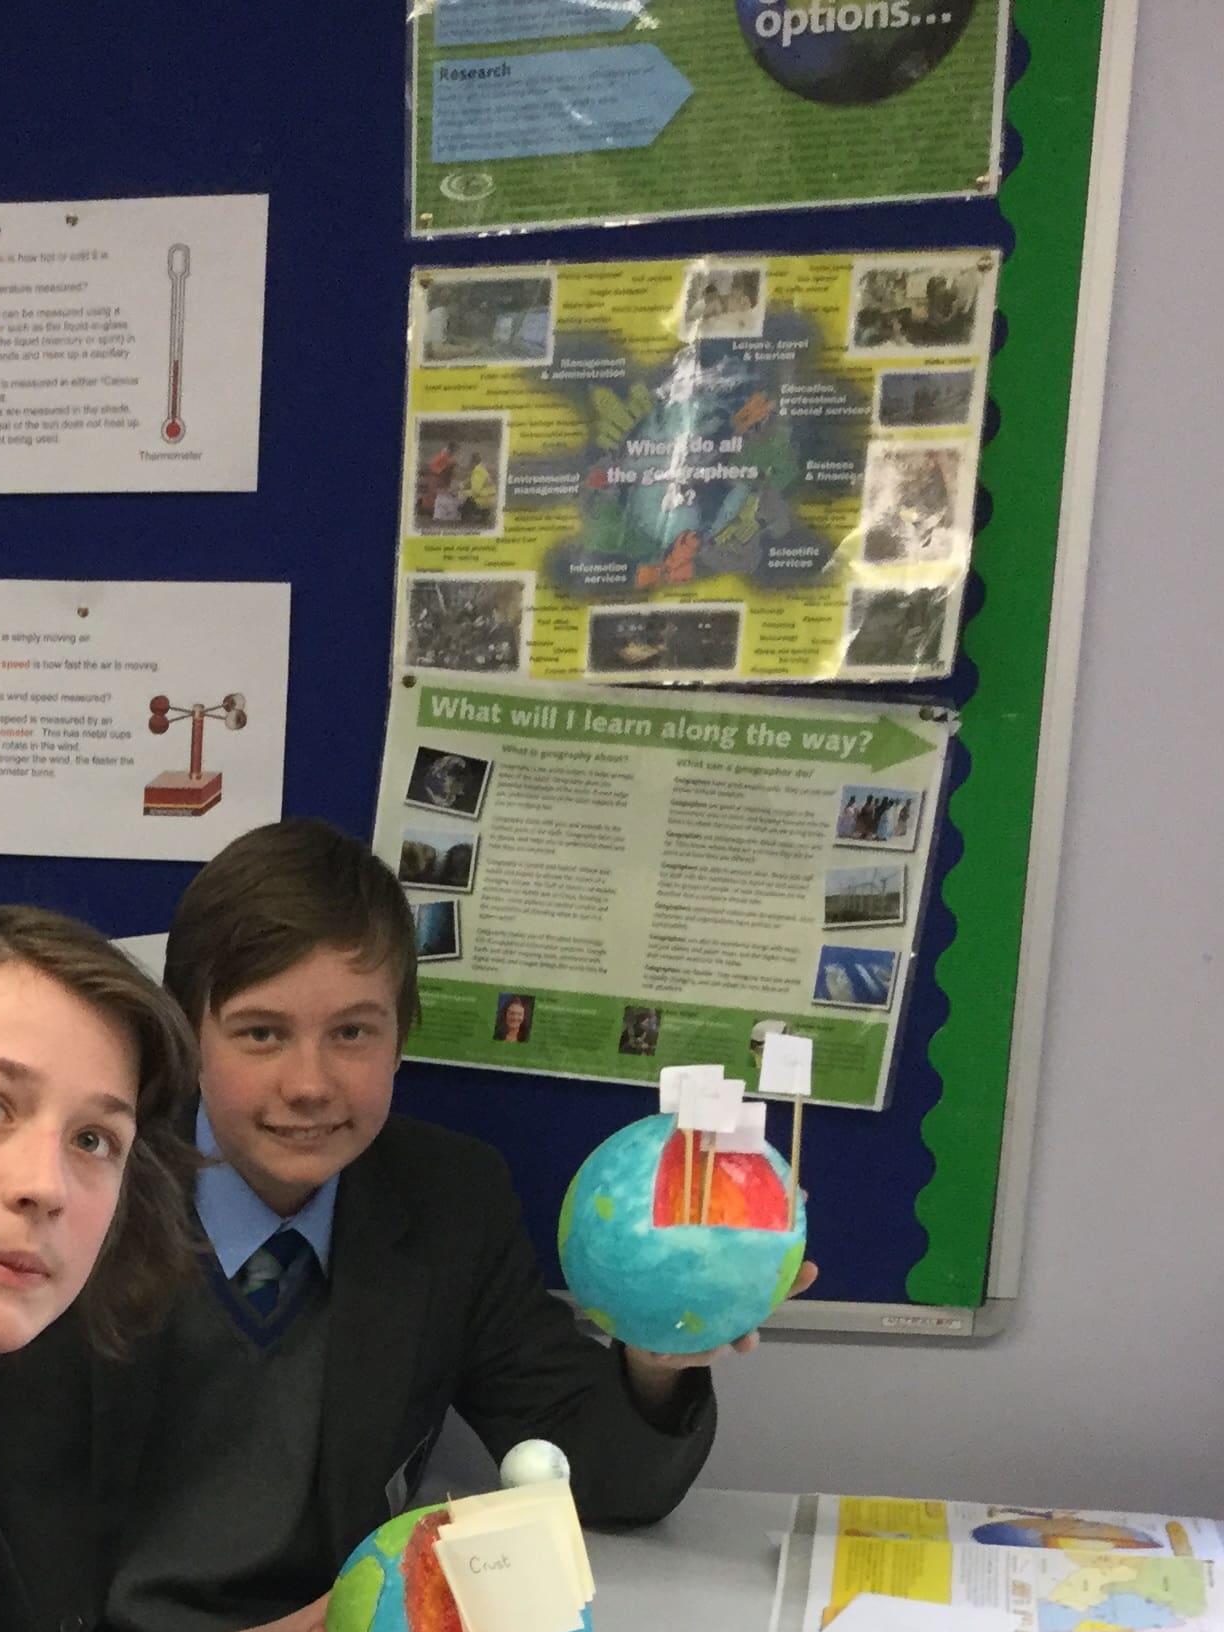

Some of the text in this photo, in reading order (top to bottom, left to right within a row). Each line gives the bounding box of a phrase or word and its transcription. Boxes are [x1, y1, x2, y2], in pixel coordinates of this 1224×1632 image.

[755, 0, 952, 47] options...
[439, 61, 511, 81] Research
[691, 437, 716, 453] do
[719, 436, 743, 453] all
[140, 450, 203, 462] Thermometer
[508, 473, 580, 486] Environmental
[607, 467, 637, 484] the
[514, 484, 579, 497] management
[769, 546, 820, 558] Scientific
[768, 558, 813, 569] services
[11, 632, 40, 644] simply
[43, 634, 76, 645] moving
[1, 659, 31, 671] speed
[43, 659, 62, 670] how
[83, 659, 97, 670] the
[431, 695, 874, 760] What will I learn along the way?
[469, 1554, 511, 1574] Crust
